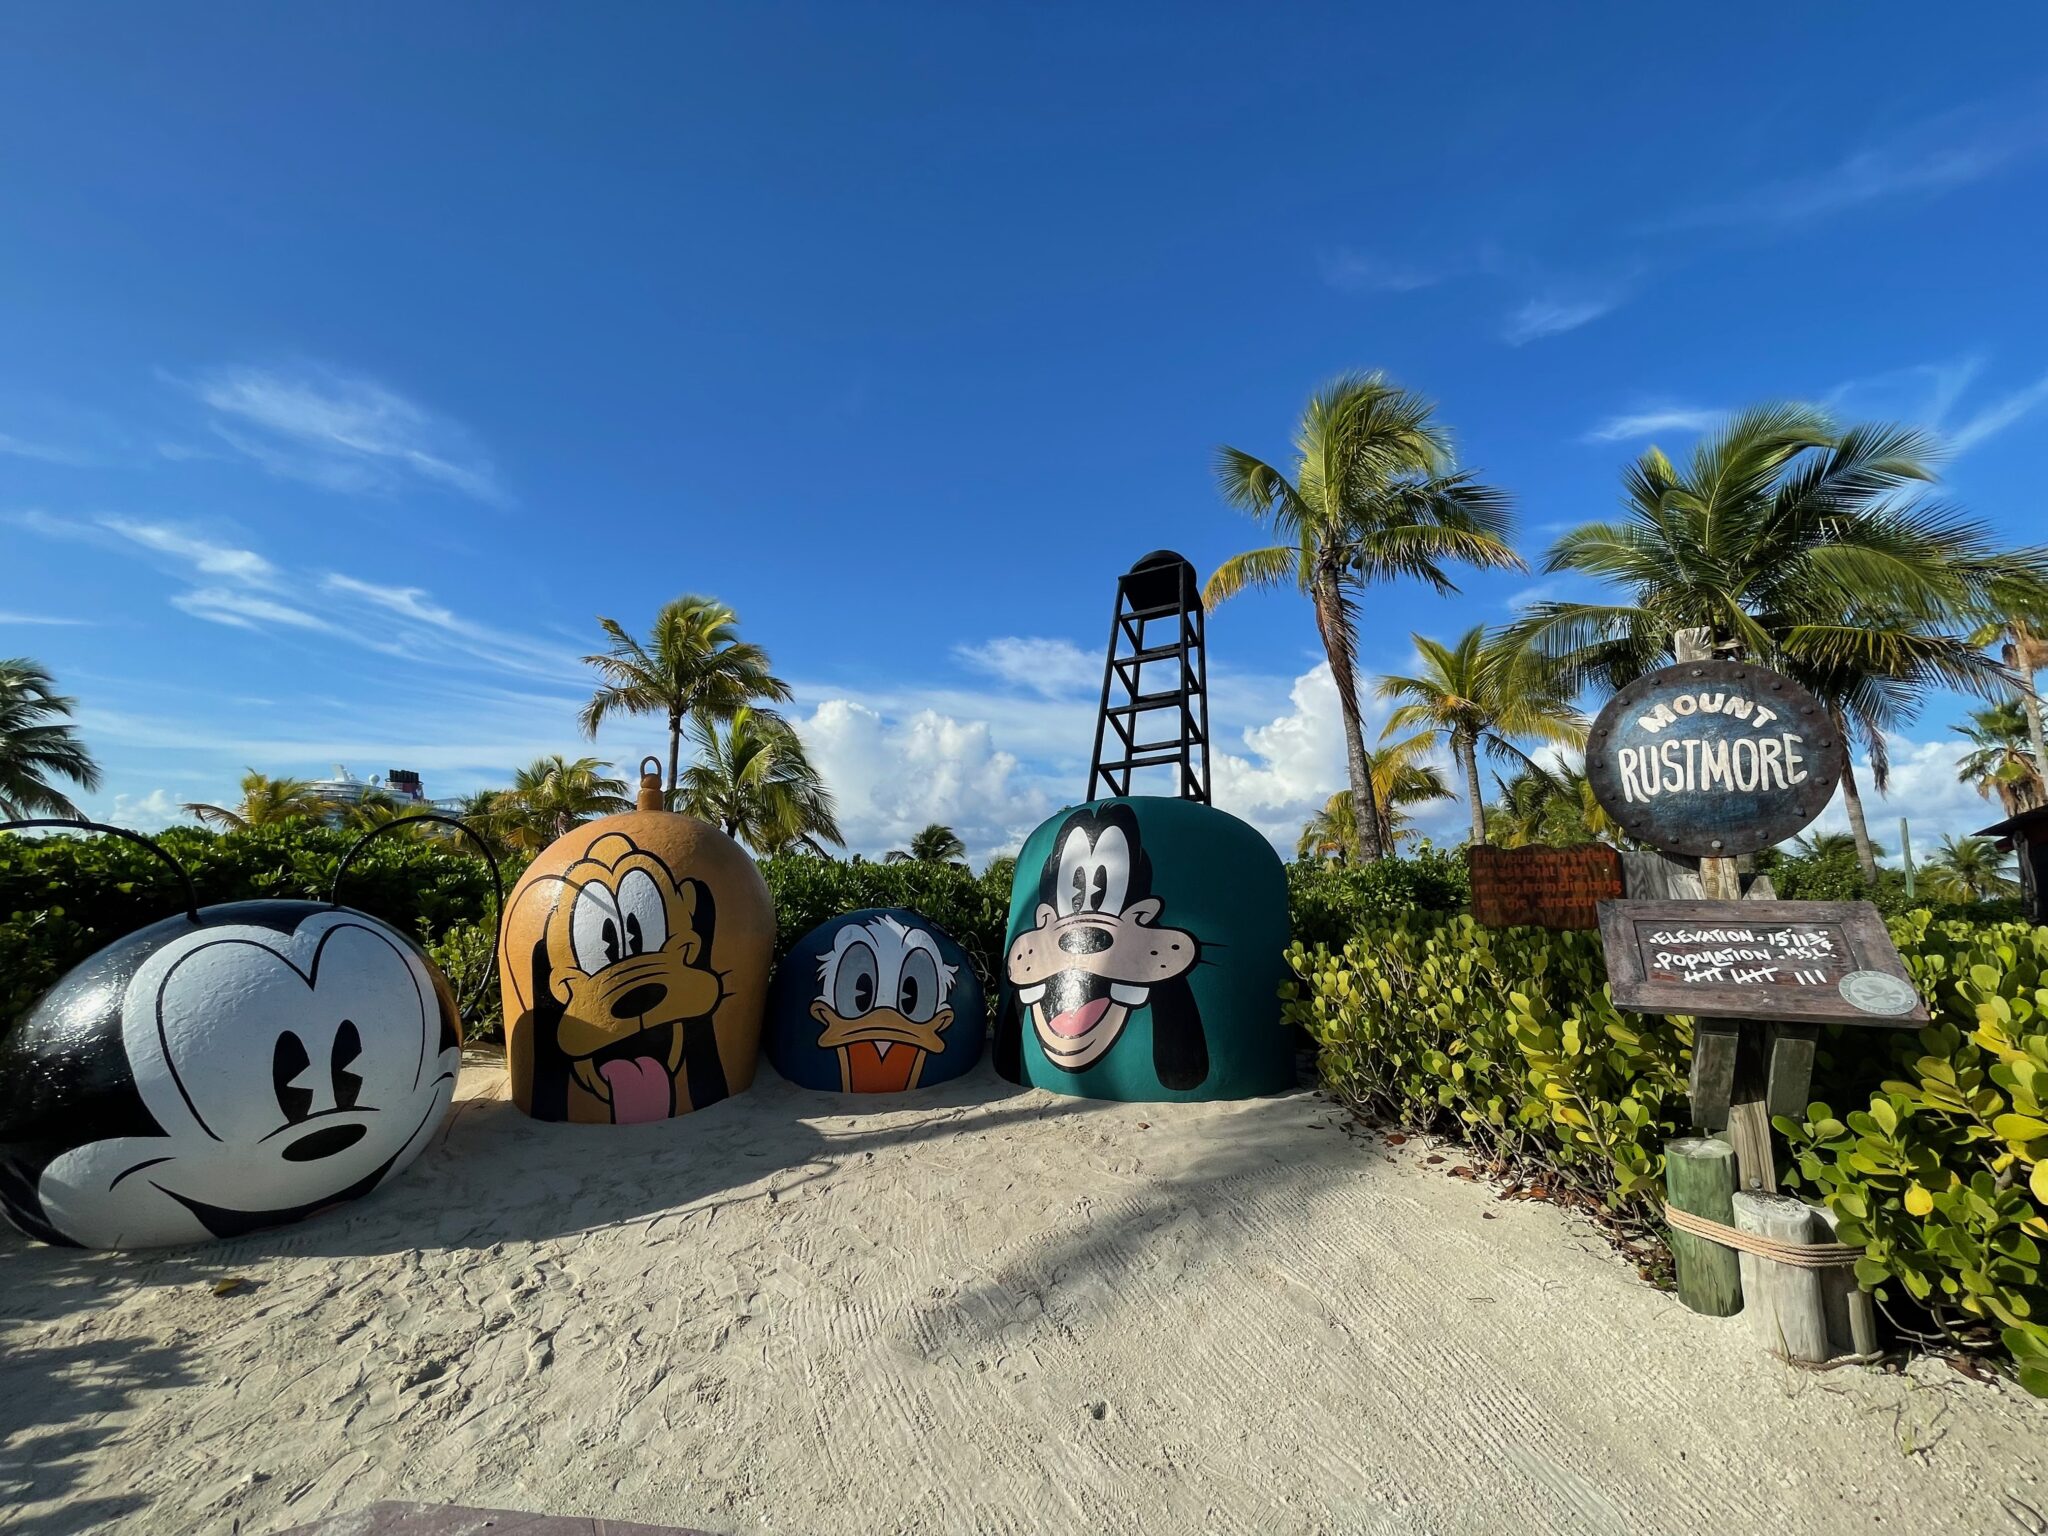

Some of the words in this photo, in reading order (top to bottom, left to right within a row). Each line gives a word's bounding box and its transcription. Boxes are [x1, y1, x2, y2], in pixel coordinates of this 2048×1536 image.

[1638, 693, 1777, 733] MOUNT
[1618, 733, 1807, 803] RUSTMORE
[1502, 854, 1535, 867] your
[1535, 854, 1566, 864] own
[1571, 850, 1616, 864] safety
[1559, 867, 1588, 879] you
[1558, 879, 1621, 894] climbing
[1480, 899, 1499, 909] on
[1504, 897, 1528, 908] the
[1653, 929, 1754, 946] ELEVATION
[1656, 948, 1772, 970] POPULATION
